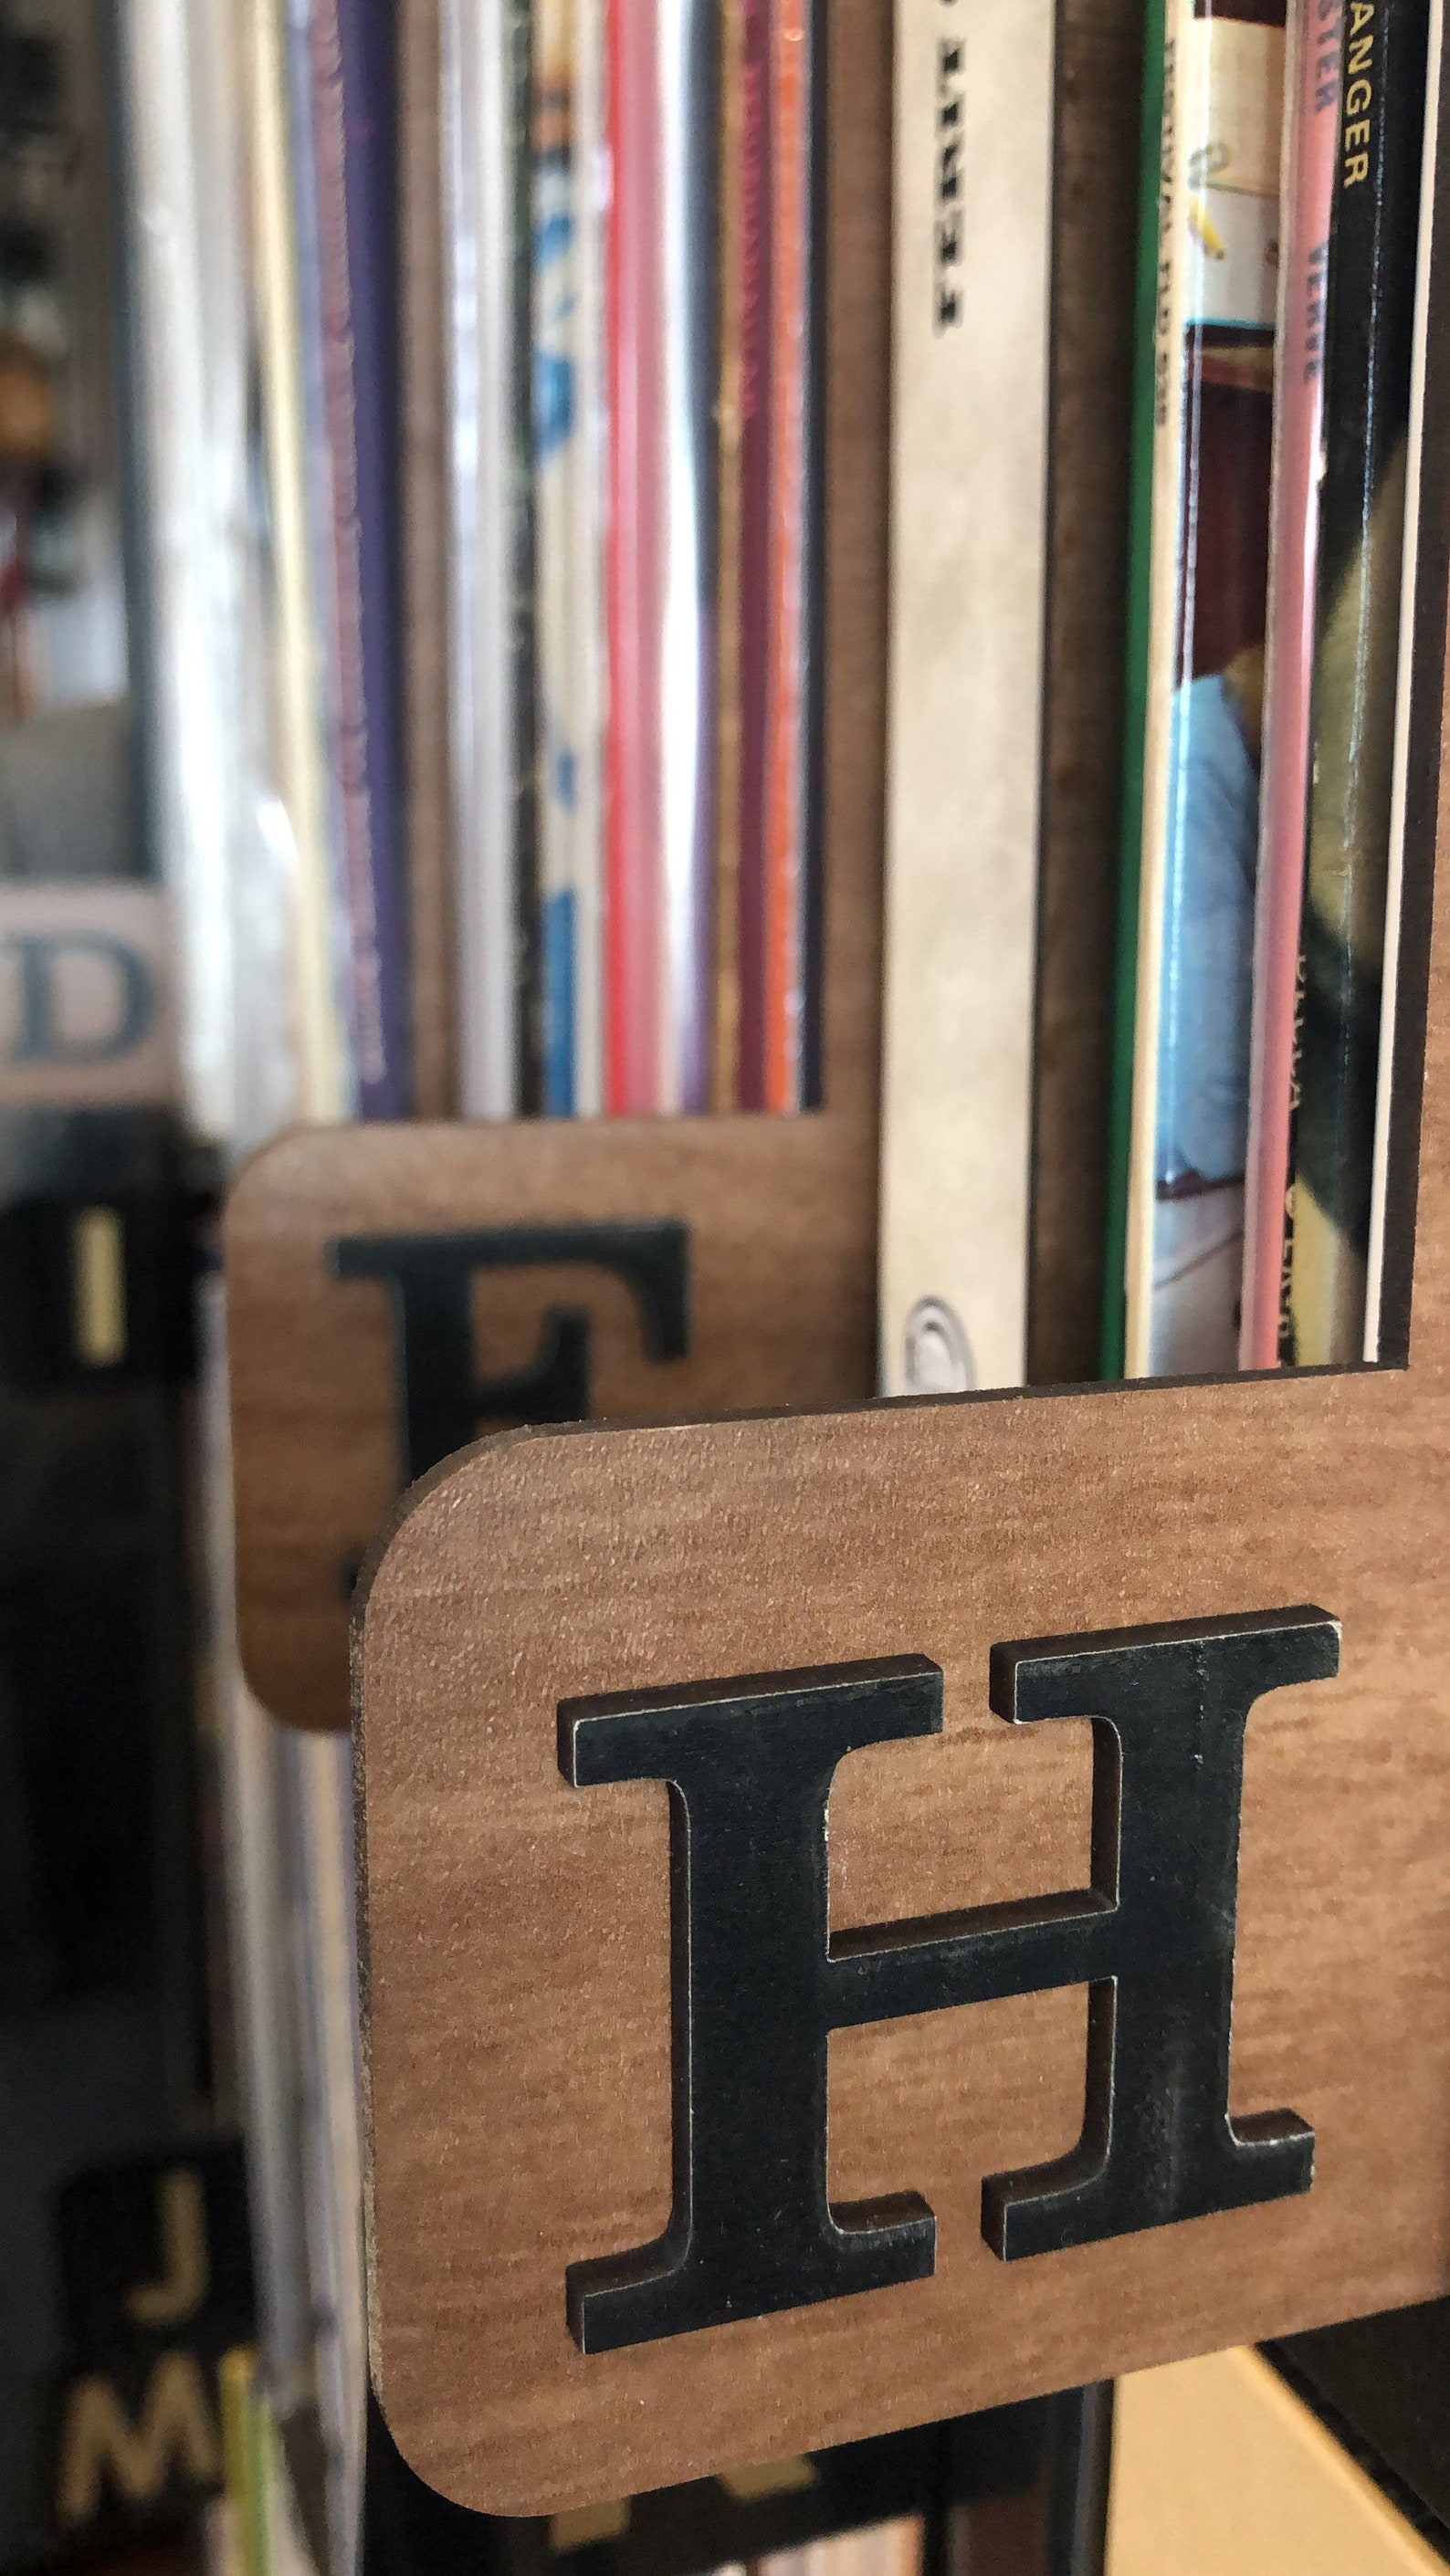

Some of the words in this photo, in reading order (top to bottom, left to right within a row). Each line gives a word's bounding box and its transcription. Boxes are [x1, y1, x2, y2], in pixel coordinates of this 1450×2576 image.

[1343, 1, 1374, 188] ANGER
[11, 925, 157, 1063] D
[558, 1602, 1344, 2355] H
[124, 2167, 211, 2330] J
[57, 2348, 226, 2529] M
